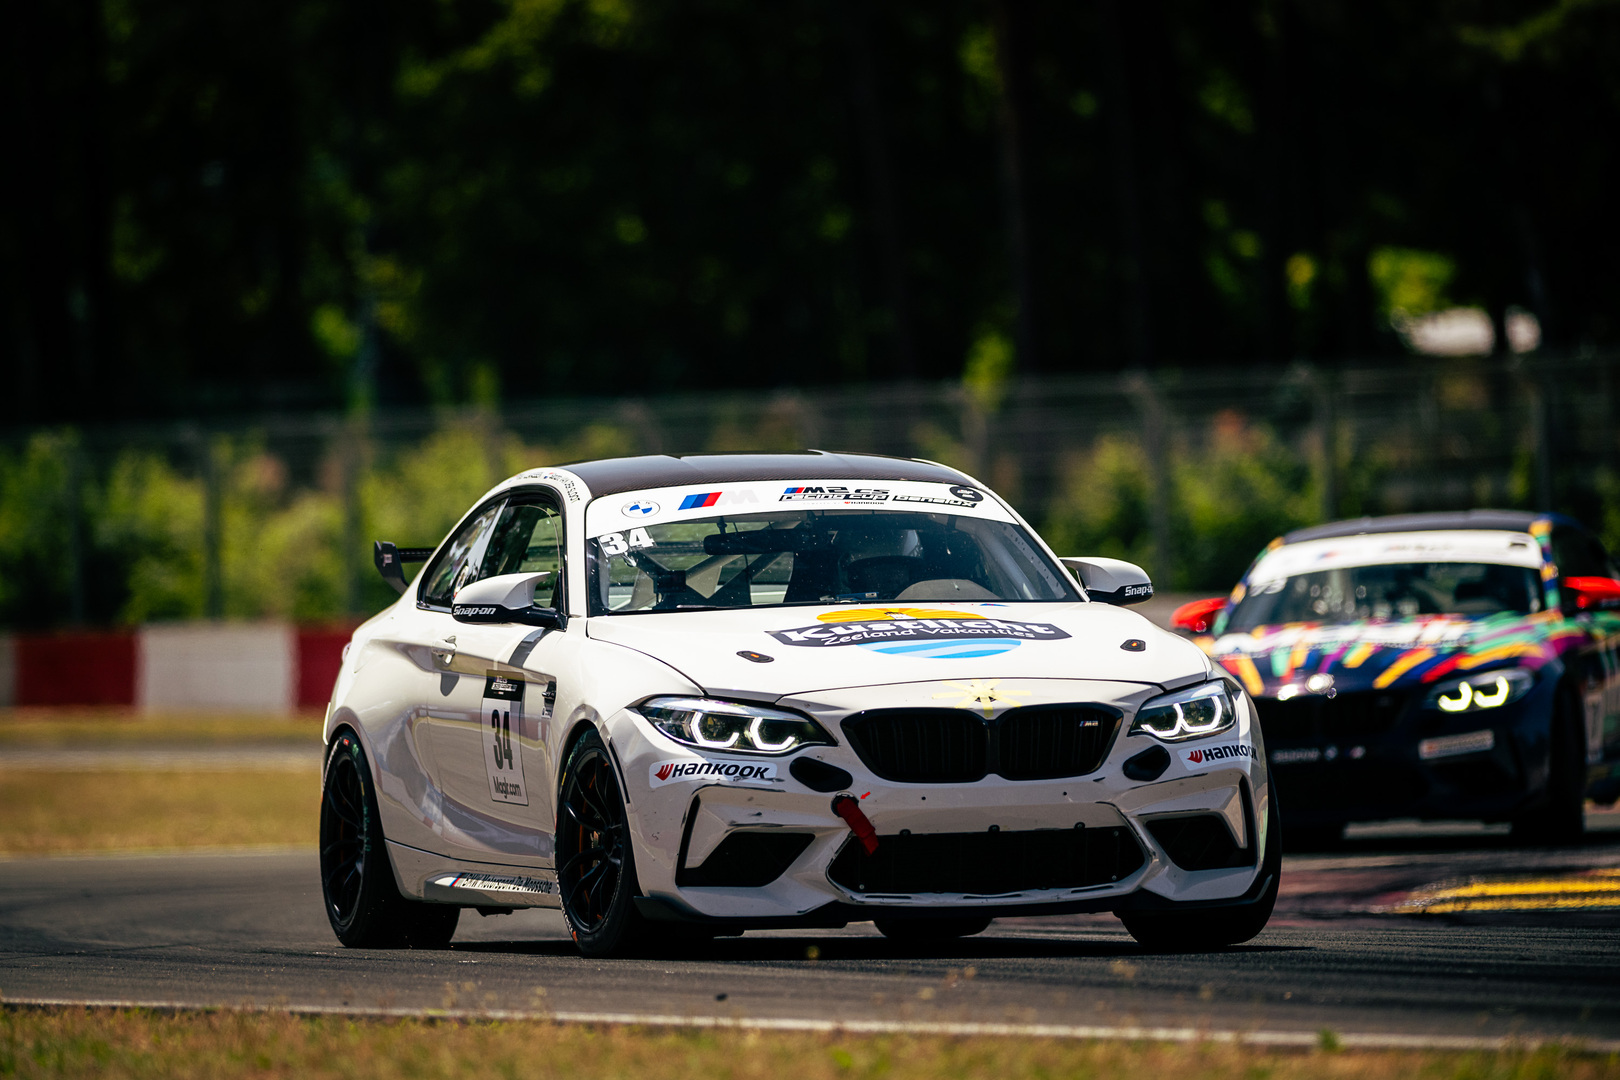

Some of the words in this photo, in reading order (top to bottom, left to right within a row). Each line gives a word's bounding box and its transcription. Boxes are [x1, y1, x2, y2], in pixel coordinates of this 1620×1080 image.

[599, 527, 655, 556] 34
[453, 605, 497, 617] Snap-on
[780, 619, 1055, 641] Kustlicht
[821, 628, 917, 646] Zeeland
[919, 627, 1035, 638] Vakanties
[491, 709, 513, 770] 34
